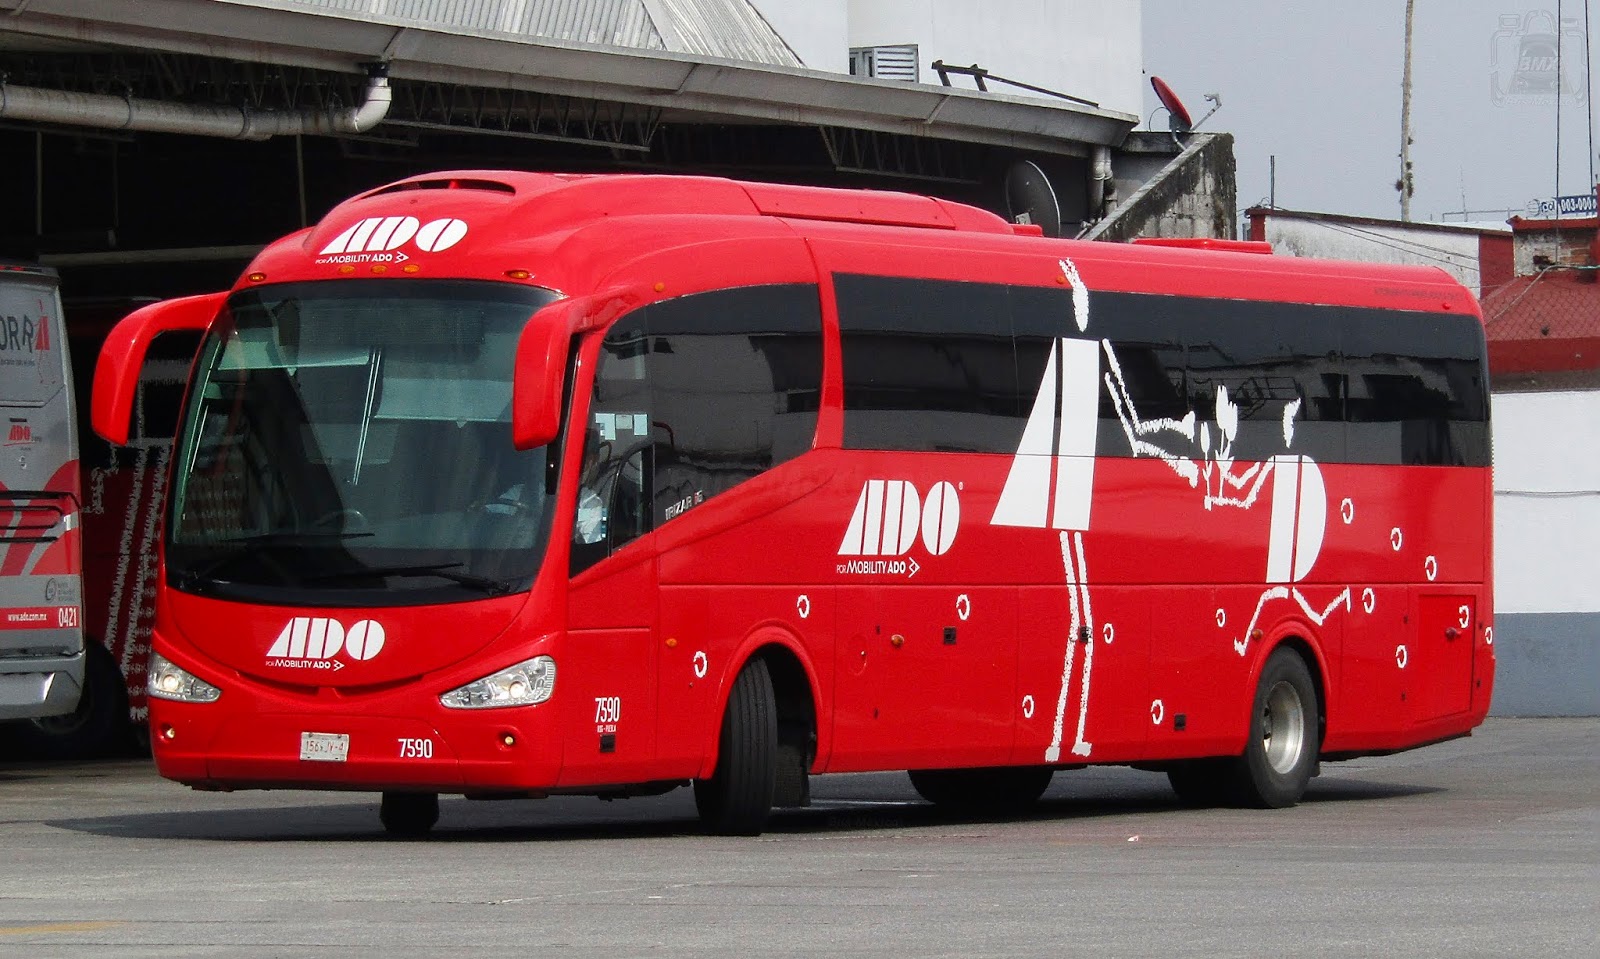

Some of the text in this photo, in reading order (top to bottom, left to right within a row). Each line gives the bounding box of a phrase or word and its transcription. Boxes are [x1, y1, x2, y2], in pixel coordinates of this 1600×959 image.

[319, 216, 468, 255] ADO
[326, 254, 371, 264] MOBILITY
[371, 253, 393, 262] ADO
[837, 480, 960, 555] ADO
[846, 560, 886, 574] MOBILITY
[887, 561, 906, 574] ADO
[58, 607, 77, 627] 0421
[266, 617, 386, 660] ADO
[274, 659, 312, 668] MOBILITY
[312, 660, 331, 669] ADO
[595, 696, 621, 723] 7590
[398, 738, 433, 759] 7590
